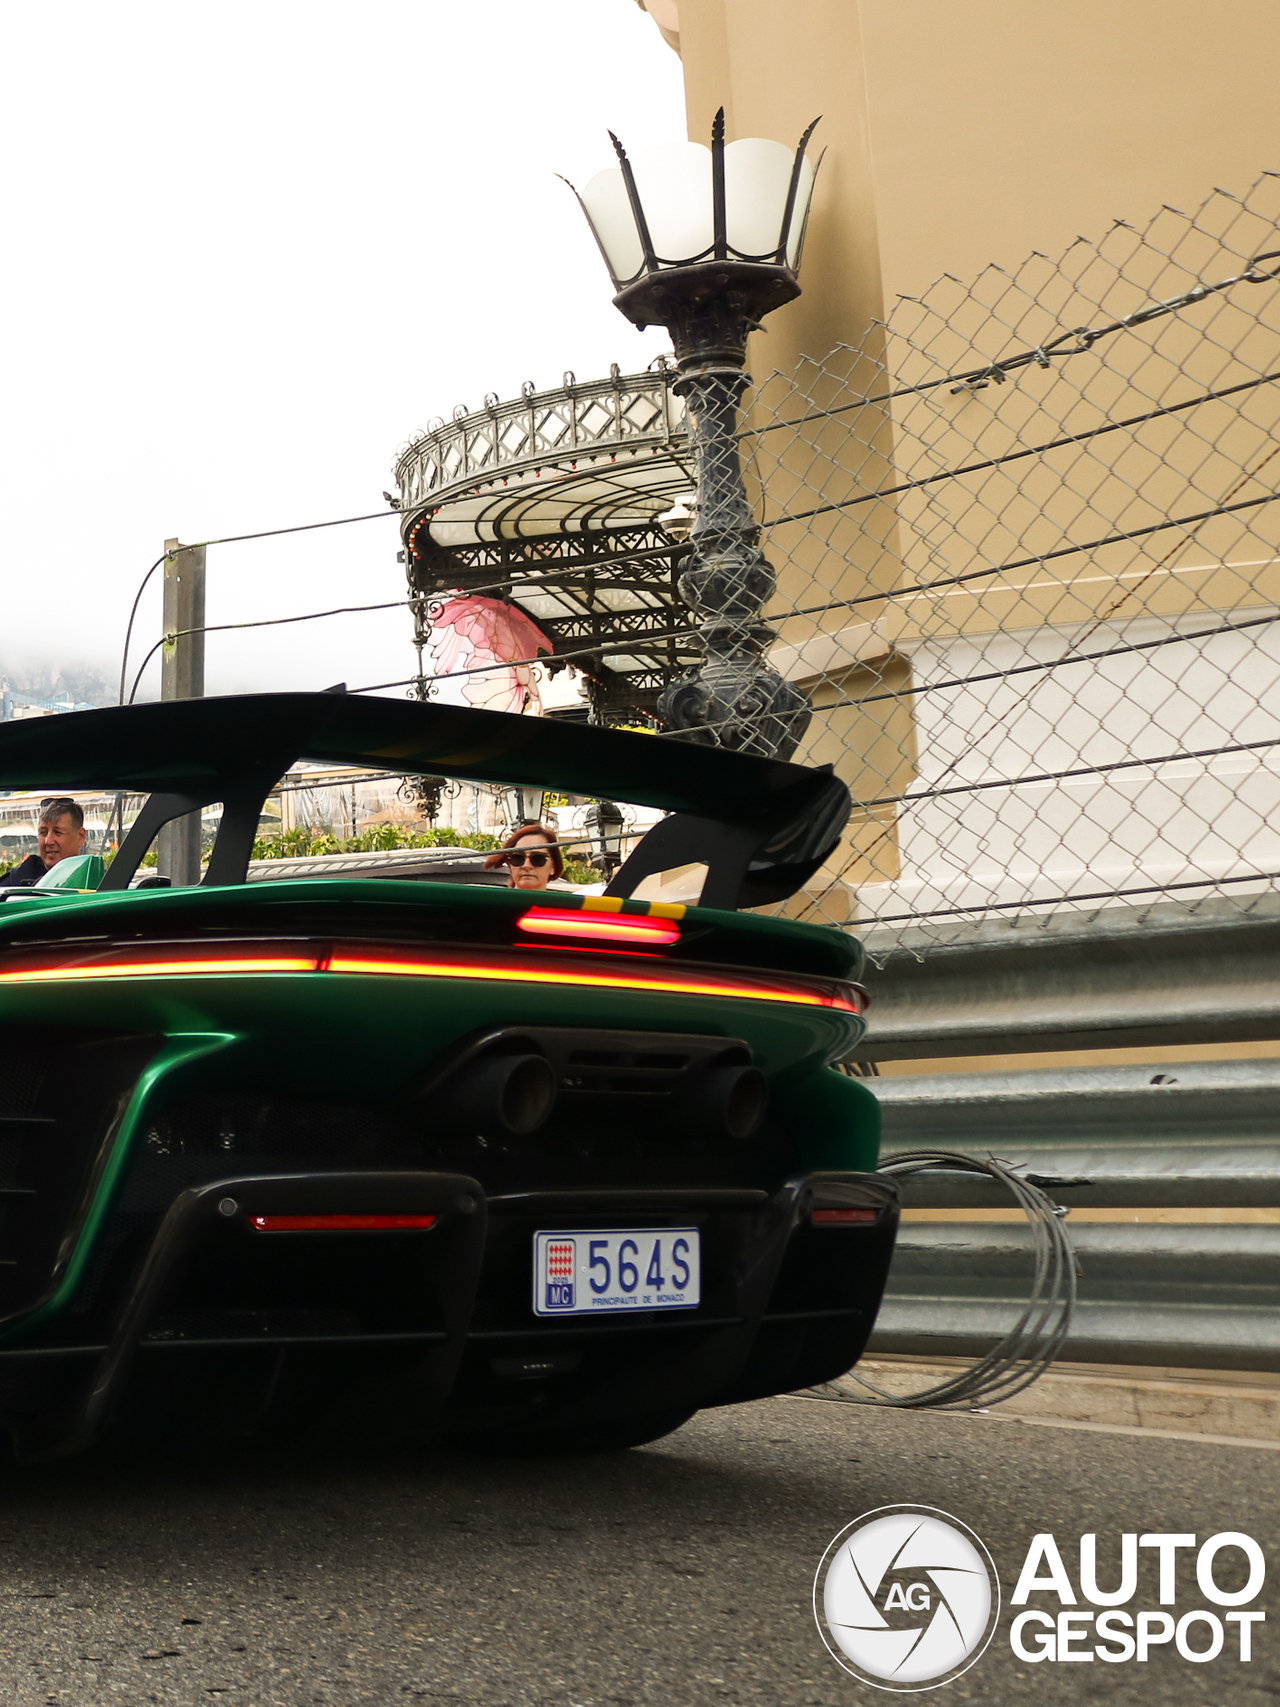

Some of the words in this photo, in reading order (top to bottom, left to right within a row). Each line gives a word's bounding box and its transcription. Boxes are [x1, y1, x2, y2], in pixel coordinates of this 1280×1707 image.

[589, 1238, 690, 1294] 564S
[552, 1276, 569, 1284] 2025
[552, 1286, 570, 1304] MC
[642, 1295, 653, 1304] DE
[656, 1293, 685, 1303] MONACO
